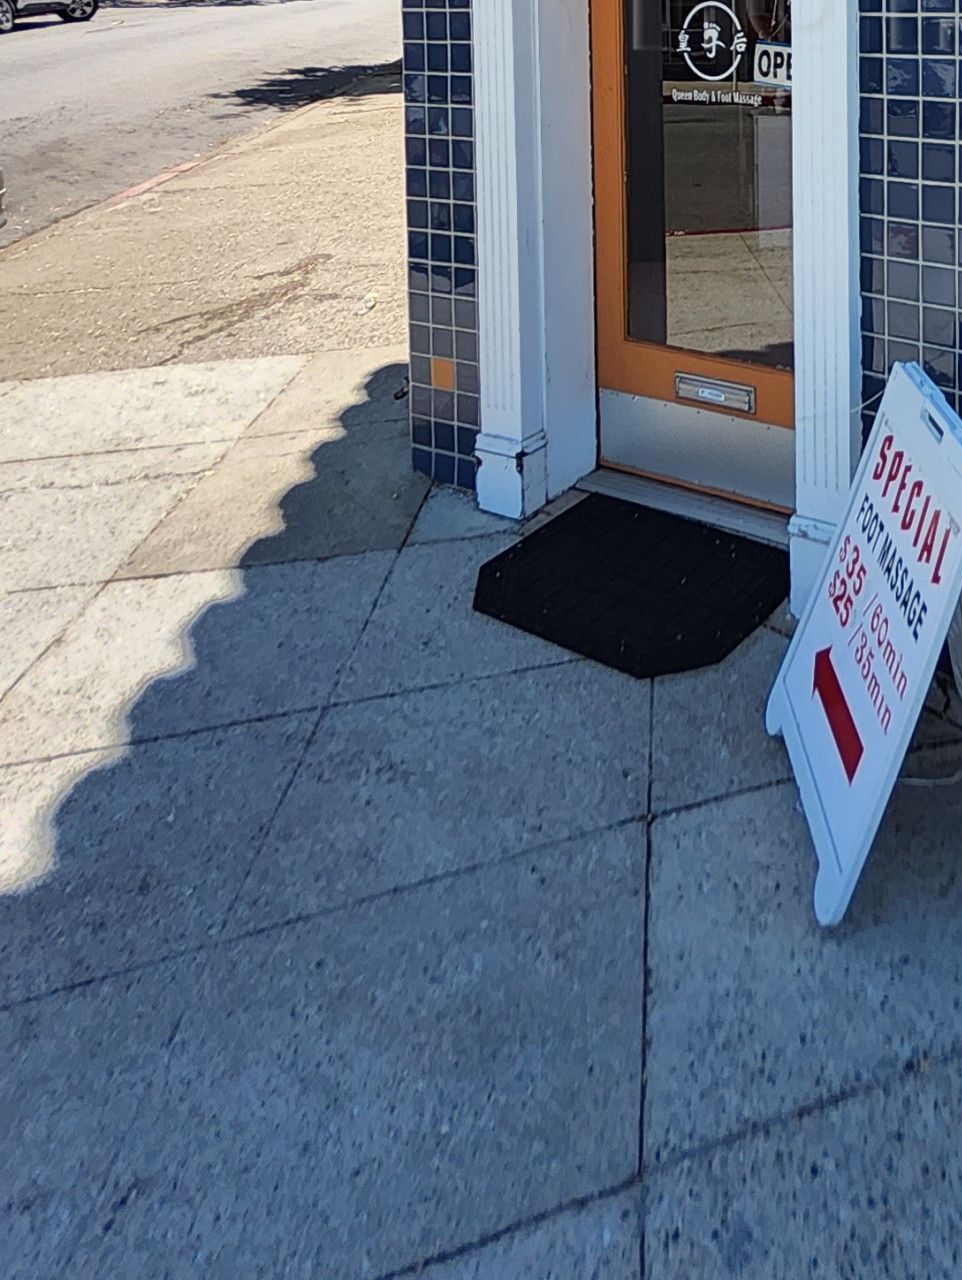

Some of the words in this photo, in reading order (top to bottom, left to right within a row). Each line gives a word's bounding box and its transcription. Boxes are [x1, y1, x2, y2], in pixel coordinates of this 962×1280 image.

[672, 88, 693, 102] Queen
[693, 89, 710, 105] Body
[717, 90, 731, 103] Foot
[732, 91, 763, 108] Massage
[872, 435, 951, 585] SPECIAL
[856, 492, 885, 554] FOOT
[877, 531, 928, 644] MASSAGE
[847, 622, 893, 736] /35min
[862, 592, 908, 702] /60min
